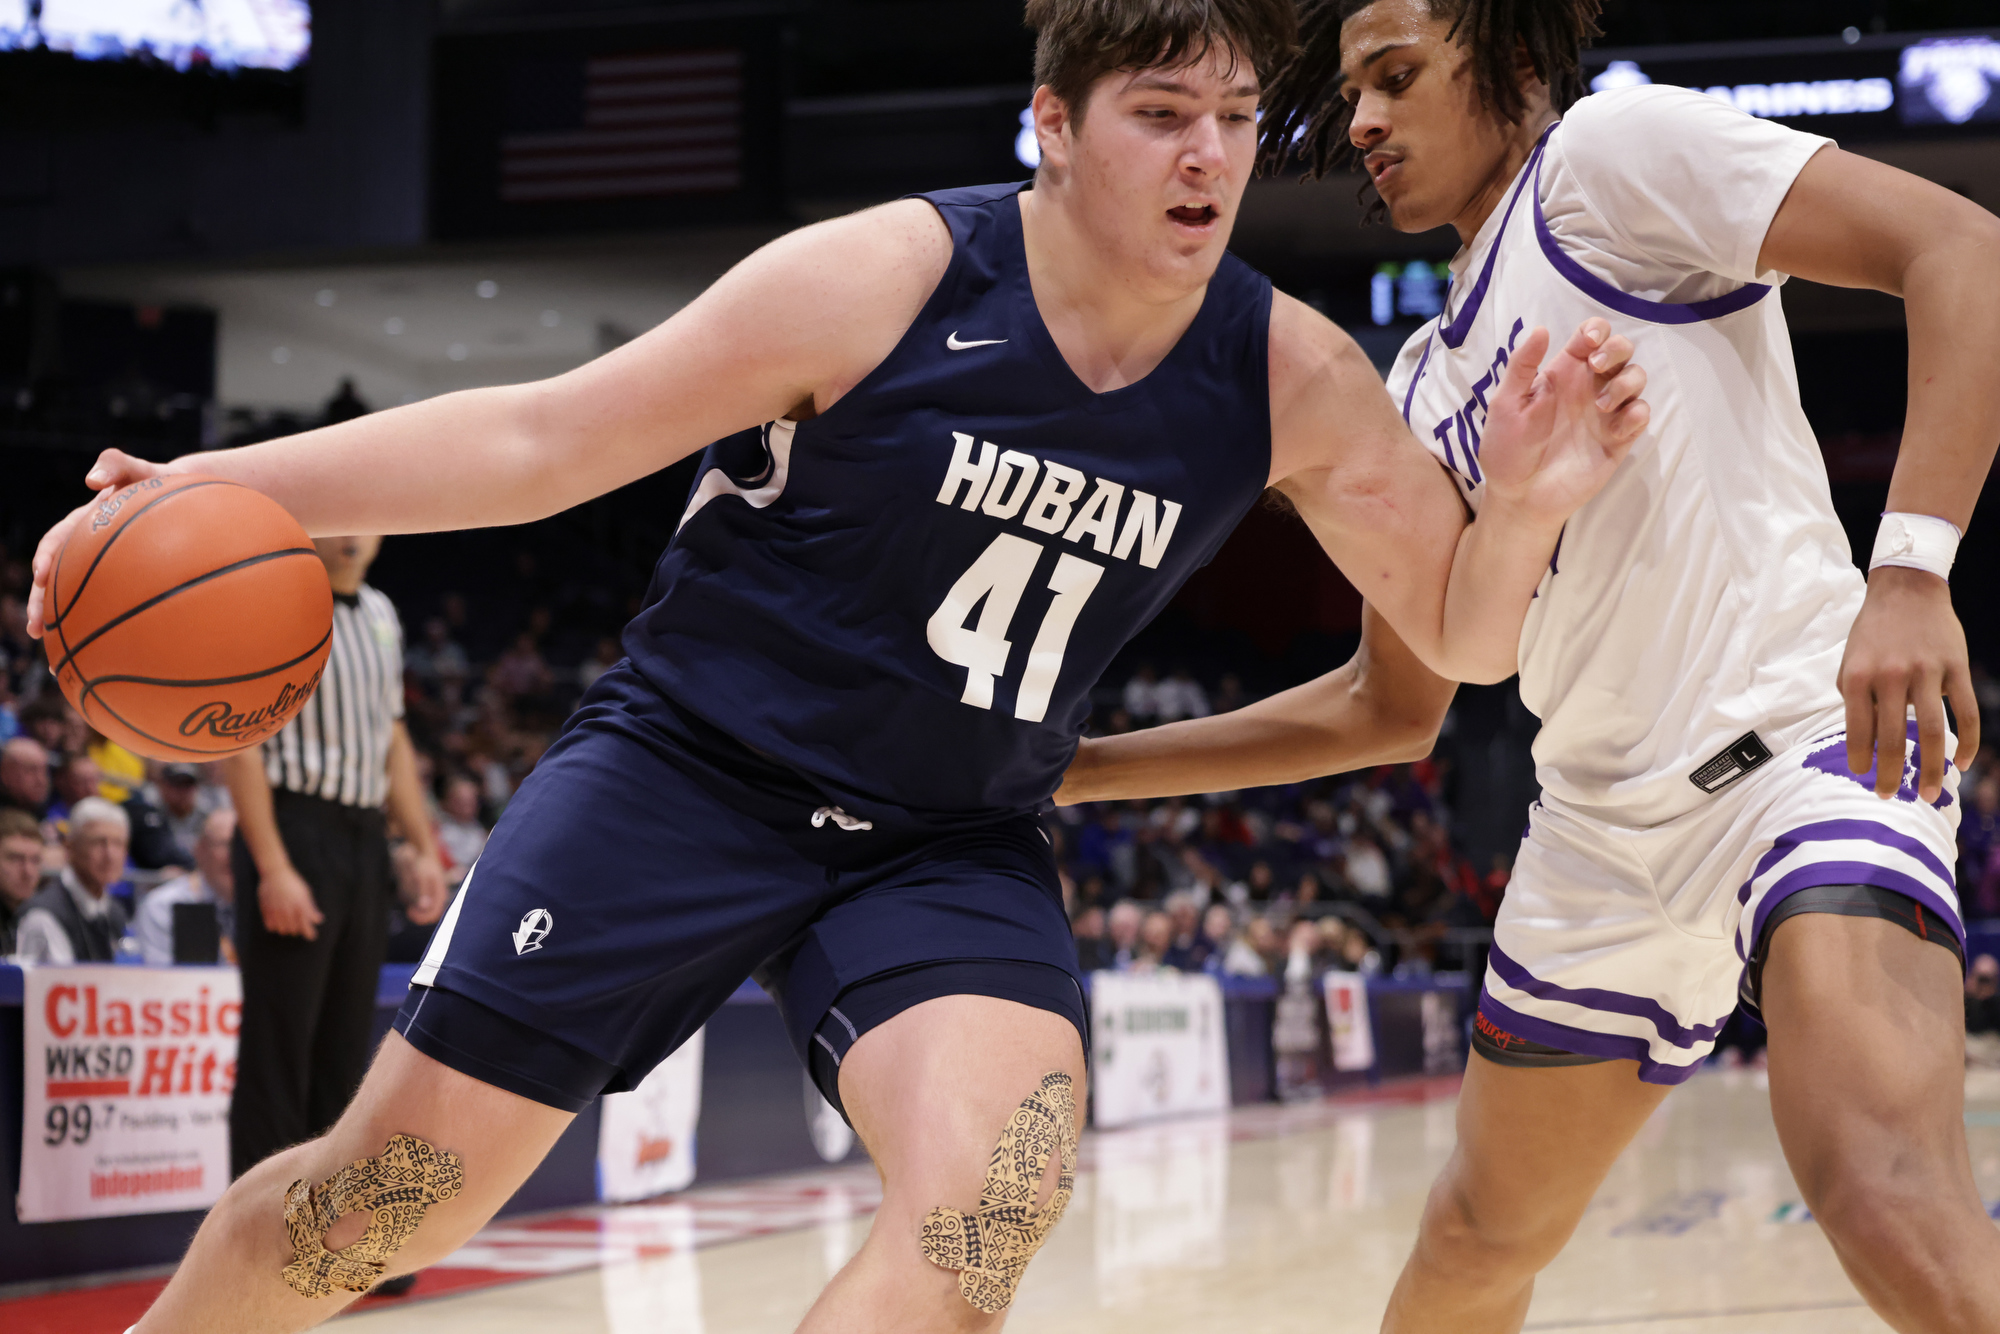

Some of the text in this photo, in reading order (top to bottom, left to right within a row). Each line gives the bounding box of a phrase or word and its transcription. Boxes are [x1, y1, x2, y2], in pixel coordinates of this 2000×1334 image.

[935, 431, 1183, 569] HOBAN
[926, 532, 1106, 723] 41
[1741, 750, 1757, 762] L
[44, 983, 242, 1039] Classic
[45, 1045, 134, 1077] WKSD
